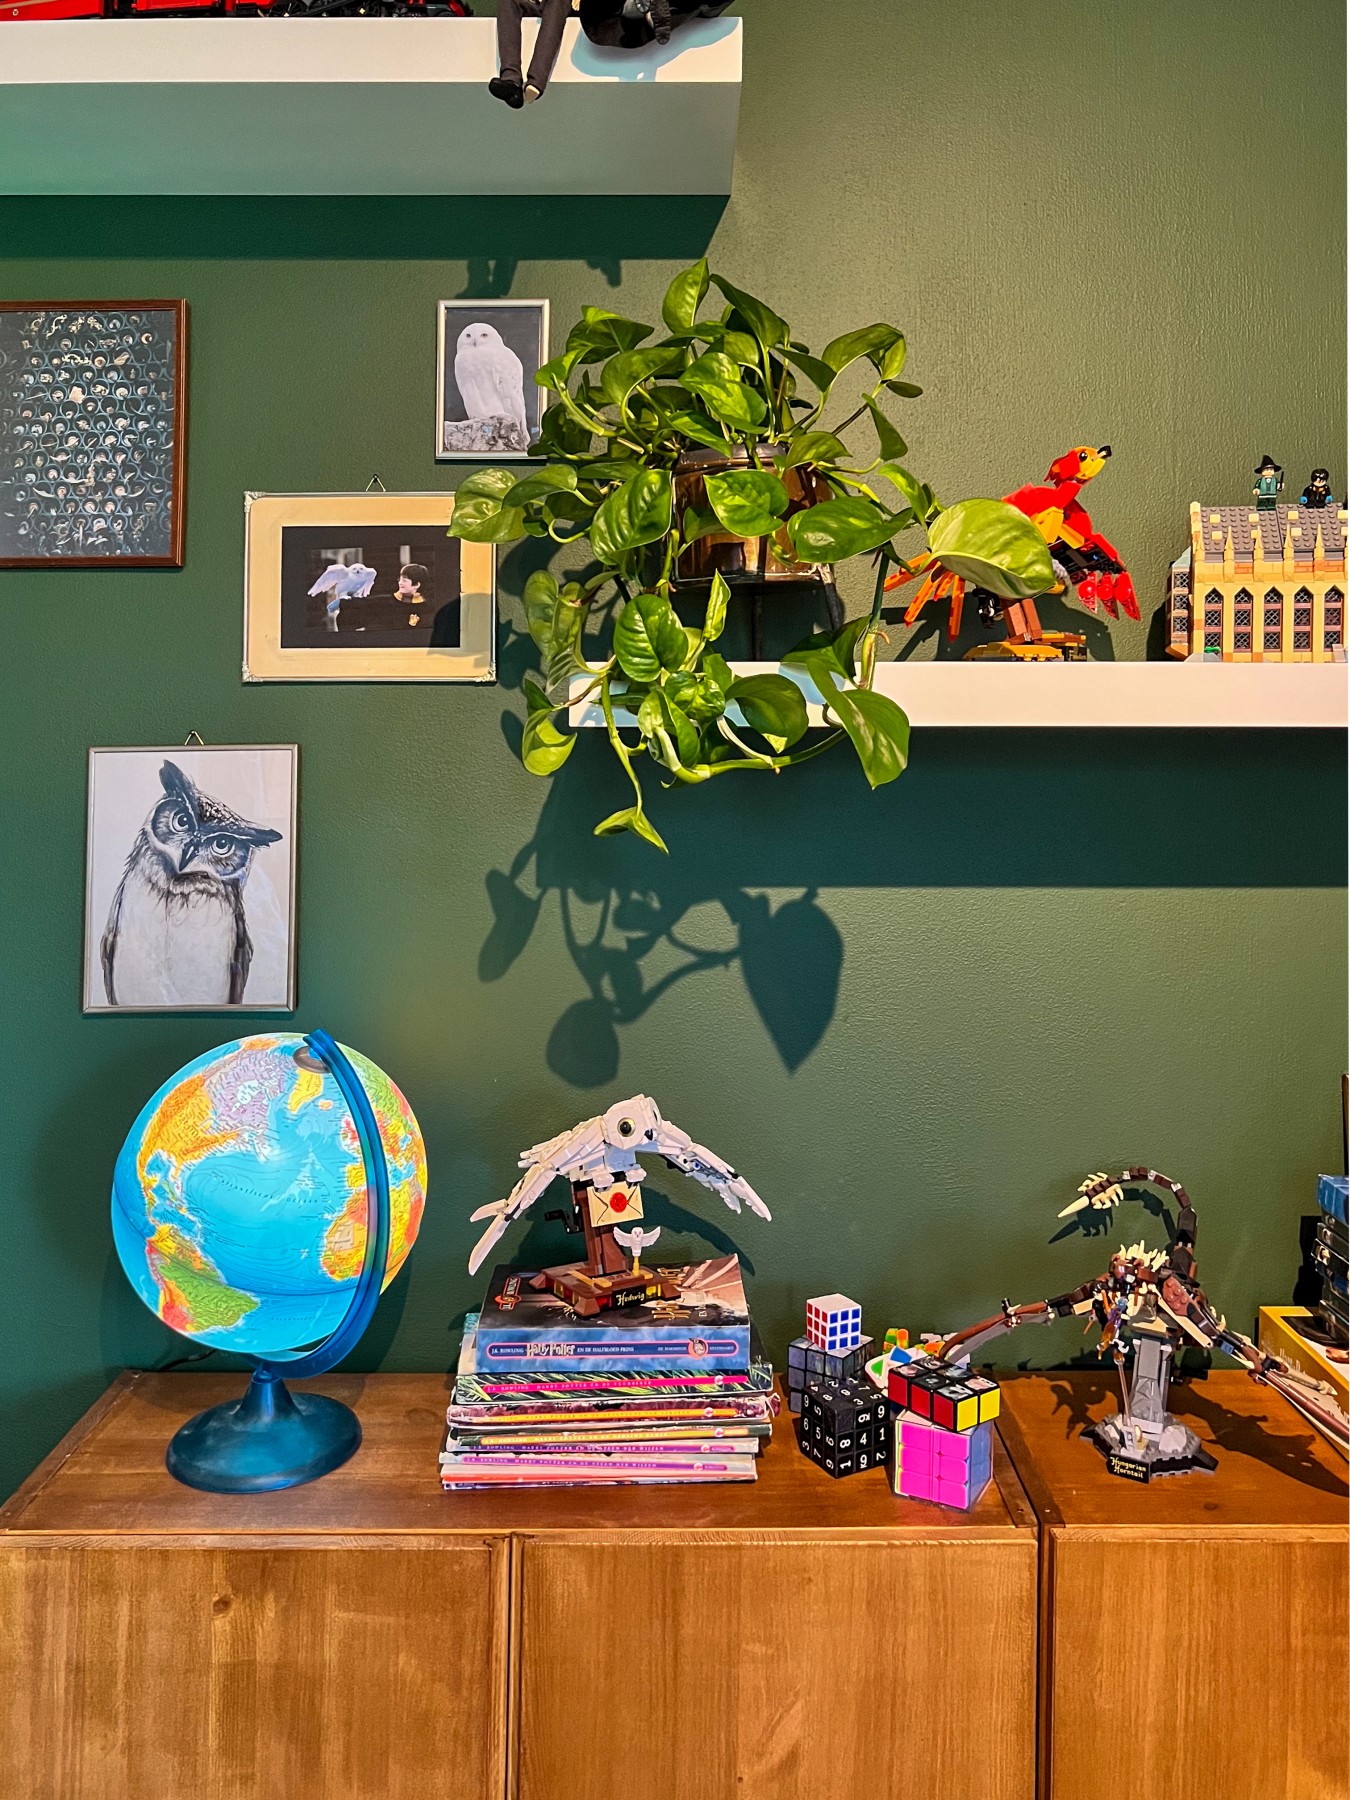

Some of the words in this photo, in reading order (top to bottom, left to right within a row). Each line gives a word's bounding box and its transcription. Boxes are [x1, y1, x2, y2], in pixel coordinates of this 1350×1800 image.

[615, 1291, 645, 1306] Hedwig
[526, 1342, 550, 1357] Harry
[550, 1342, 576, 1357] Potter
[816, 1426, 822, 1439] 5
[839, 1438, 852, 1449] 8
[859, 1432, 868, 1445] 4
[879, 1427, 886, 1441] 1
[839, 1459, 852, 1470] 1
[876, 1450, 887, 1461] 2
[1110, 1456, 1147, 1472] Hungarian
[1113, 1463, 1144, 1478] Horntail
